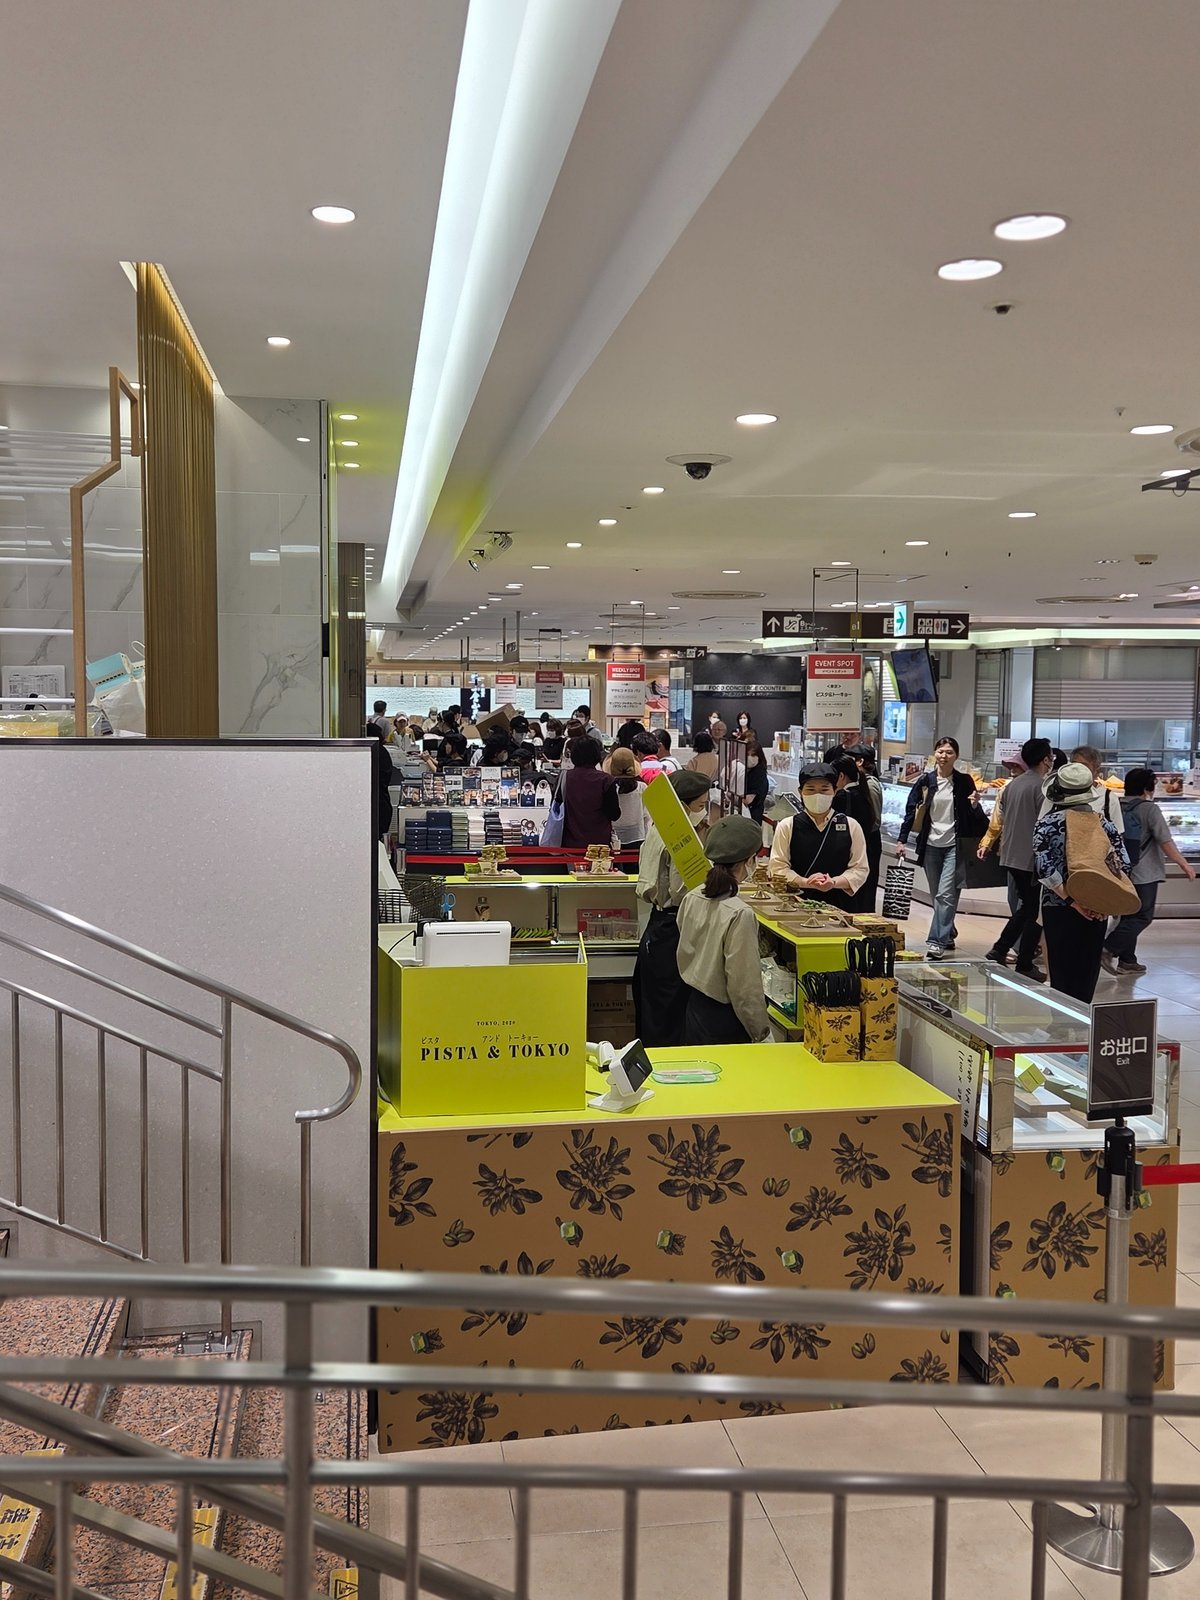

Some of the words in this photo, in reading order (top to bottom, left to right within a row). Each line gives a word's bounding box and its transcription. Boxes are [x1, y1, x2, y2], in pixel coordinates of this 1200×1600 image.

[421, 1036, 440, 1045] ピスタ
[482, 1034, 500, 1043] アンド
[508, 1034, 539, 1042] トーキョー
[1100, 1036, 1148, 1056] お出口
[420, 1046, 478, 1061] PISTA
[487, 1045, 500, 1059] &
[508, 1043, 570, 1058] TOKYO
[1116, 1057, 1130, 1066] Exit
